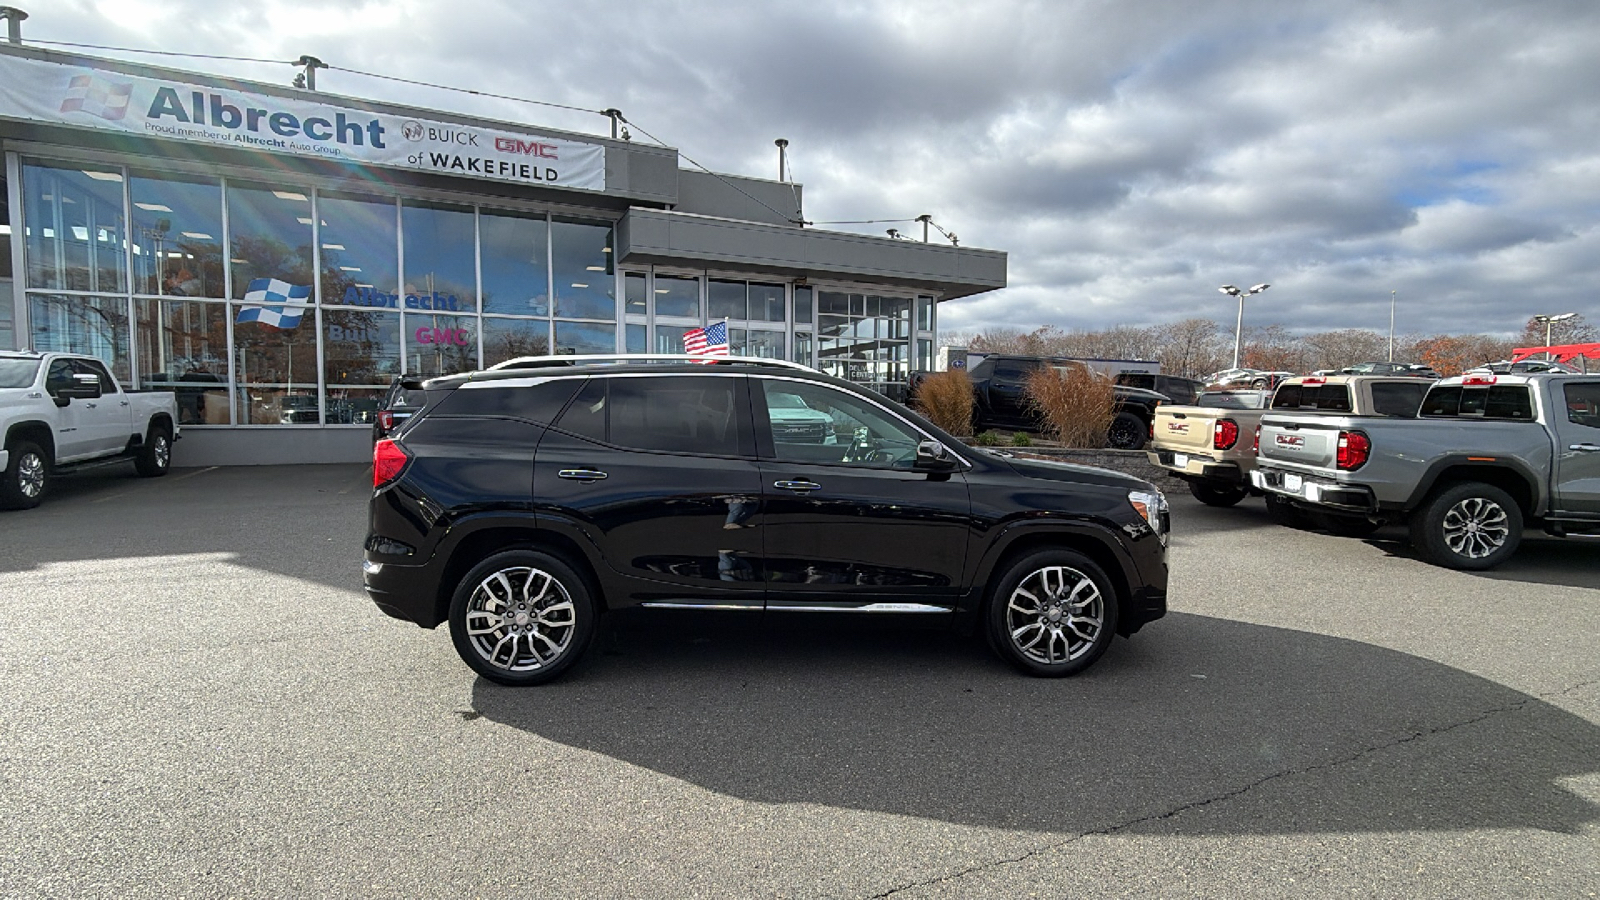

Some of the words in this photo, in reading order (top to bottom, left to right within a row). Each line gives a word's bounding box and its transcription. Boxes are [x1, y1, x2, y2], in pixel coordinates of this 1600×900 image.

[147, 86, 386, 149] Albrecht
[144, 121, 176, 134] Proud
[177, 127, 219, 141] member
[220, 132, 232, 141] of
[233, 134, 286, 148] Albrecht
[289, 141, 311, 152] Auto
[312, 145, 341, 156] Group
[428, 127, 479, 147] BUICK
[495, 138, 558, 160] GMC
[407, 152, 424, 165] of
[430, 152, 558, 181] WAKEFIELD
[343, 287, 458, 311] Albrecht
[415, 326, 468, 345] GMC
